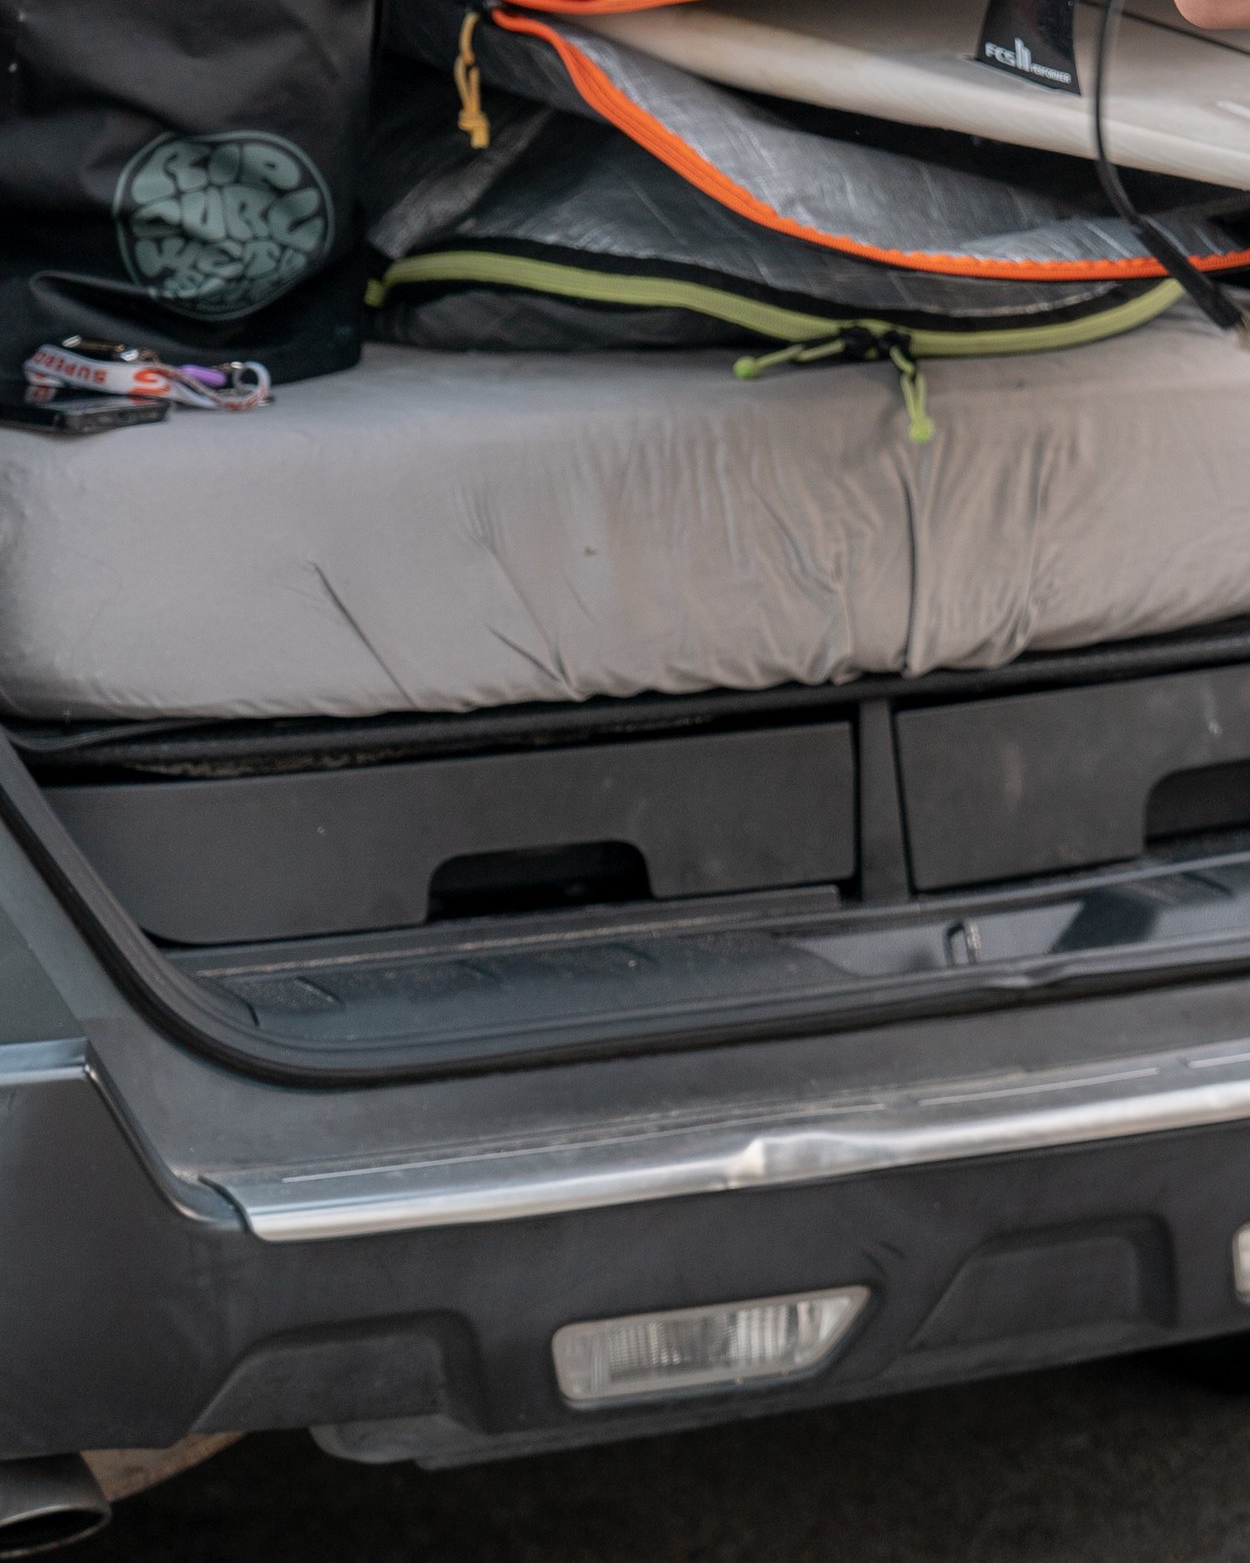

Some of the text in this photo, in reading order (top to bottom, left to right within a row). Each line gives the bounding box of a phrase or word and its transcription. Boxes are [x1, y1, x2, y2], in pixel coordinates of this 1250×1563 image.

[985, 42, 1016, 68] FCS
[1030, 63, 1072, 85] PERFORMER
[132, 140, 300, 204] RIP
[132, 186, 324, 253] CURL
